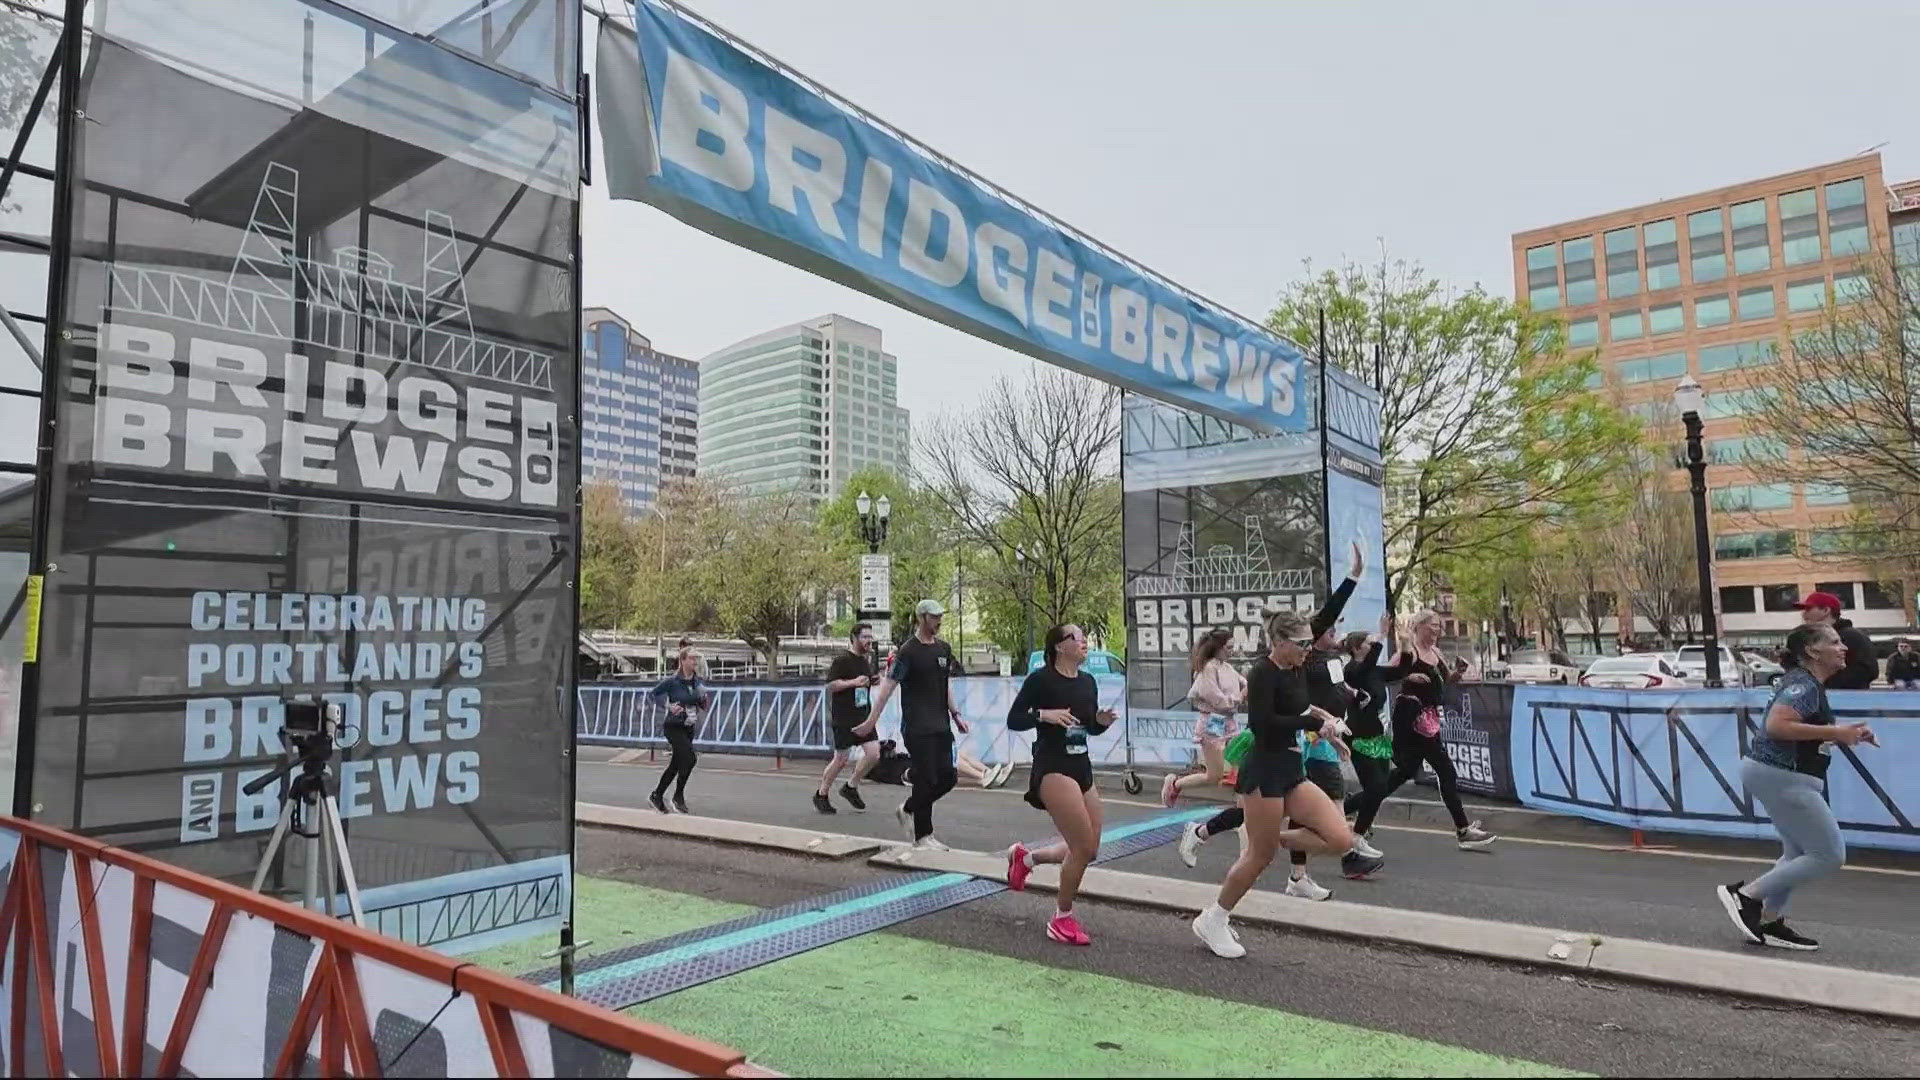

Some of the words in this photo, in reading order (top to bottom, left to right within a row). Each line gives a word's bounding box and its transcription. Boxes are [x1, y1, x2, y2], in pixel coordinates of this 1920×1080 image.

[660, 47, 1076, 340] BRIDGE
[1109, 284, 1297, 417] BREWS
[97, 322, 514, 445] BRIDGE
[93, 395, 514, 501] BREWS
[190, 590, 487, 633] CELEBRATING
[187, 640, 484, 688] PORTLAND'S
[188, 778, 216, 834] AND
